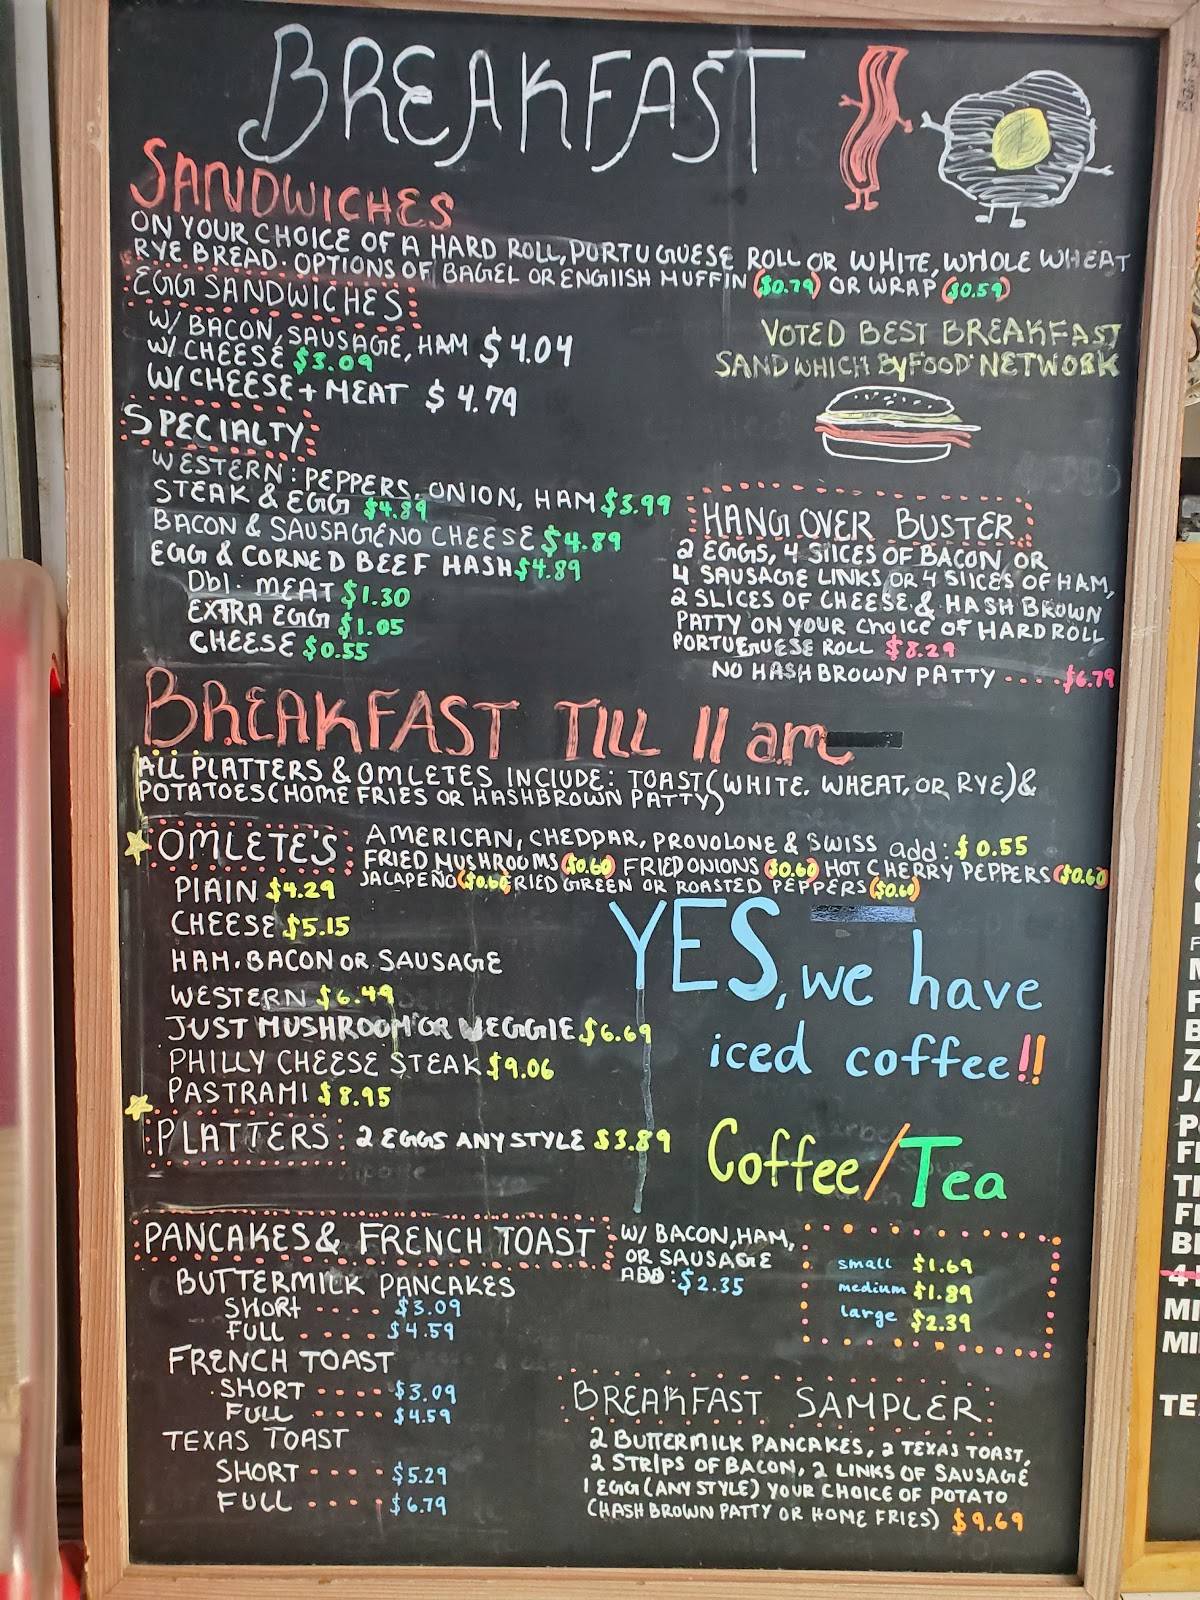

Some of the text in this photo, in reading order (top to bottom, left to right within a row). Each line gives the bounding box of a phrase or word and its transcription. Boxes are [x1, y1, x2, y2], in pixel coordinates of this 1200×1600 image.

[238, 22, 806, 174] BREAKFAST
[129, 137, 455, 231] SANDWICHES
[131, 211, 172, 234] ON
[181, 215, 244, 242] YOUR
[255, 223, 350, 253] CHOICE
[431, 234, 497, 261] HARD
[747, 249, 800, 270] ROLL
[943, 250, 1031, 272] WHOLE
[1040, 248, 1131, 272] WHEAT
[135, 238, 181, 262] RYE
[299, 251, 394, 279] OPTIONS
[443, 263, 519, 284] BAGEL
[661, 272, 747, 290] MUFFIN
[869, 275, 937, 296] WRAP
[134, 266, 401, 321] EGG SANDWICHES
[419, 333, 468, 356] HAM
[762, 318, 1121, 348] VOTED BEST BREAKFAST
[184, 339, 373, 374] CHEESE $3.09
[979, 352, 1120, 378] NETWORK
[123, 403, 305, 453] SPECIALTY
[154, 479, 427, 523] STEAK EGG $4.89
[535, 488, 595, 513] HAM
[601, 486, 672, 518] $3.99
[153, 508, 621, 558] BACON CHEESE $4.89
[896, 508, 1017, 541] BUSTER
[151, 540, 582, 582] EGG CORNED BEEF HASH $4.89
[920, 546, 1002, 569] BACON
[1014, 552, 1049, 570] OR
[700, 565, 808, 587] SAUSAGE
[819, 569, 881, 588] LINKS
[256, 577, 411, 609] MEAT $1.30
[695, 590, 1101, 624] SLICES CHEESE HASH BROWN
[187, 598, 404, 639] EXTRA EGG $1.05
[677, 611, 846, 636] PATTY ON YOUR
[189, 629, 368, 662] CHEESE $0.55
[822, 636, 956, 661] ROLL $8.29
[712, 661, 1115, 694] NO PATTY $6.79
[144, 665, 855, 766] BREAKFAST TILL am
[359, 762, 492, 786] OMLETES
[358, 784, 724, 815] FRIES OR PATTY)
[157, 828, 336, 866] OMLETE'S
[653, 831, 775, 853] PROVOLONE
[807, 832, 877, 853] SWISS
[364, 849, 427, 870] FRIED
[436, 852, 558, 871] MUSHROOMS
[867, 858, 953, 880] CHERRY
[961, 863, 1051, 884] PEPPERS
[265, 877, 335, 904] $4.29
[643, 878, 666, 894] OR
[677, 879, 761, 894] ROASTED
[773, 878, 866, 896] PEPPERS
[171, 911, 350, 942] CHEESE $5.15
[247, 948, 503, 973] BACON SAUSAGE
[802, 962, 874, 1007] we
[909, 929, 1043, 1011] have
[171, 985, 395, 1012] WESTERN $6.49
[165, 1015, 248, 1040] JUST
[579, 1016, 651, 1046] $6.69
[710, 1020, 812, 1075] iced
[170, 1048, 554, 1081] PHILLY CHEESE STEAK $9.06
[169, 1077, 391, 1107] PASTRAMI $8.95
[356, 1125, 671, 1154] 2 EGGS ANY STYLE $3.89
[359, 1222, 597, 1256] FRENCH TOAST
[660, 1250, 772, 1269] SAUSAGE
[838, 1253, 972, 1276] small $1.69
[177, 1269, 515, 1298] BUTTERMILK PANCAKES
[677, 1268, 744, 1296] $2.35
[838, 1279, 973, 1304] medium $1.89
[395, 1298, 462, 1318] $3.09
[840, 1303, 972, 1333] large $2.39
[227, 1320, 455, 1342] FULL $4.59
[169, 1344, 396, 1376] FRENCH TOAST
[220, 1378, 456, 1403] SHORT $3.09
[572, 1379, 982, 1423] BREAKFAST SAMPLER
[226, 1402, 452, 1425] FULL $4.59
[163, 1428, 349, 1451] TEXAS TOAST
[614, 1428, 741, 1453] BUTTERMILK
[901, 1440, 959, 1457] TEXAS
[216, 1459, 447, 1485] SHORT $5.29
[613, 1454, 684, 1472] STRIPS
[836, 1462, 895, 1481] LINKS
[935, 1464, 1029, 1486] SAUSAGE
[217, 1490, 446, 1516] FULL $6.79
[767, 1481, 1007, 1504] YOUR CHOICE POTATO
[649, 1502, 1023, 1536] BROWN PATTY OR HOME FRIES) $9.69
